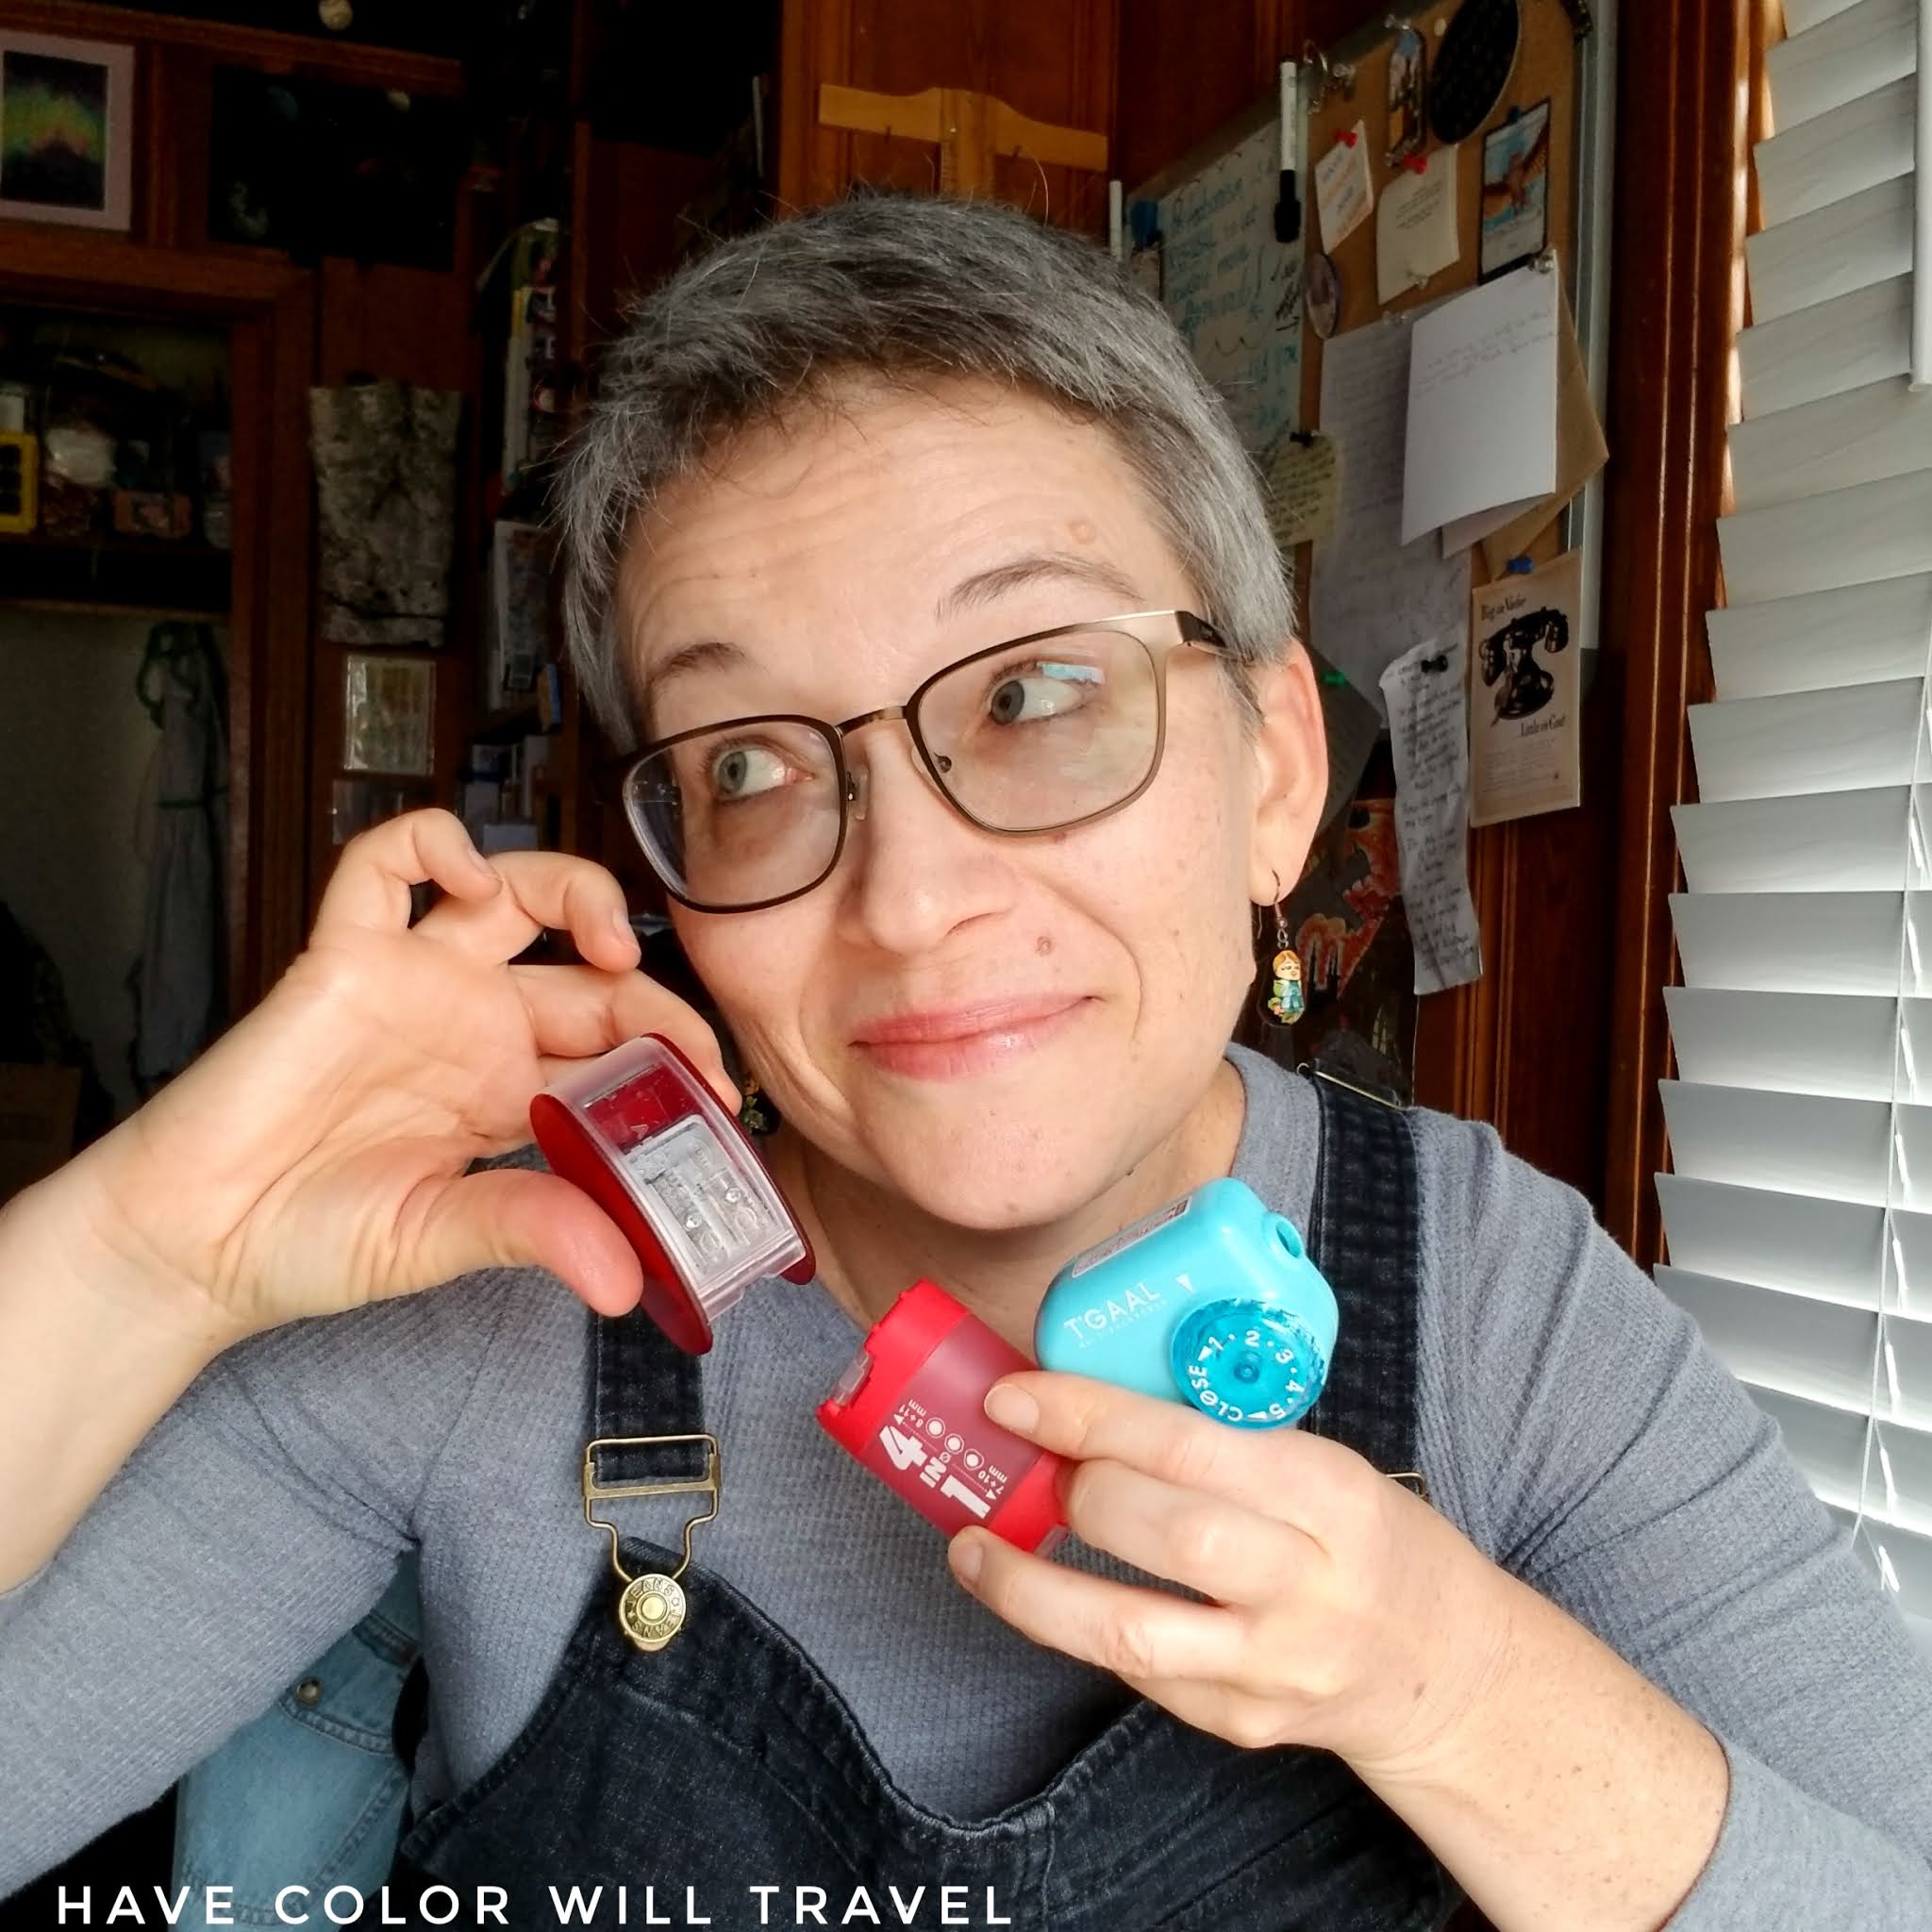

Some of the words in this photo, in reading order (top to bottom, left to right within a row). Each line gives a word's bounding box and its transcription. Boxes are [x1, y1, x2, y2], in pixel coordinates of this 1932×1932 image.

[1208, 1336, 1224, 1352] 1
[1244, 1329, 1261, 1348] 2
[1274, 1348, 1294, 1365] 3
[1188, 1364, 1243, 1422] CLOSE
[1285, 1379, 1306, 1393] 4
[1268, 1403, 1287, 1420] 5
[625, 1576, 675, 1607] JEANS
[631, 1610, 682, 1639] JEANS
